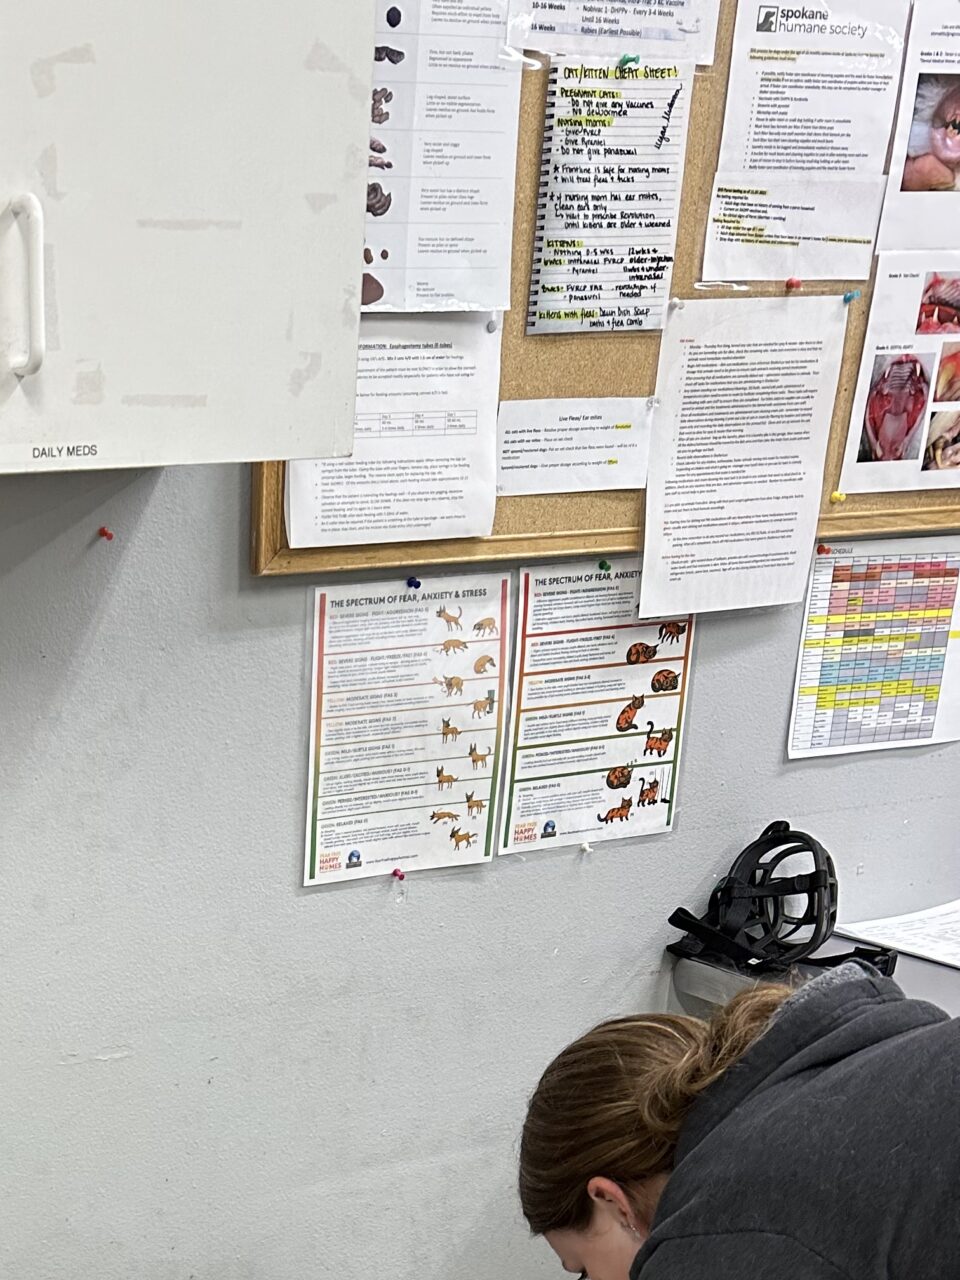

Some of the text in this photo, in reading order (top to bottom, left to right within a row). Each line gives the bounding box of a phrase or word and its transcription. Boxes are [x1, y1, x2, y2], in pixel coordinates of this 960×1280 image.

[533, 2, 547, 10] 10-16
[548, 3, 565, 11] Weeks
[633, 8, 647, 16] Every
[648, 8, 657, 16] 3-4
[657, 9, 674, 17] Weeks
[780, 7, 828, 23] spokane
[595, 16, 602, 24] 16
[602, 17, 620, 25] Weeks
[538, 24, 555, 32] Weeks
[581, 26, 597, 35] Rabies
[779, 21, 867, 39] humane society
[644, 66, 678, 78] SHEET!
[596, 101, 608, 109] give
[611, 101, 623, 110] any
[621, 220, 636, 228] older
[644, 219, 671, 228] weaned
[554, 248, 582, 259] Nothing
[32, 445, 97, 458] DAILY MEDS
[535, 577, 547, 586] THE
[548, 574, 582, 586] SPECTRUM
[584, 573, 593, 582] OF
[595, 572, 613, 583] FEAR,
[330, 599, 344, 608] THE
[346, 595, 385, 607] SPECTRUM
[387, 593, 397, 603] OF
[398, 592, 419, 604] FEAR,
[421, 591, 454, 601] ANXIETY
[462, 588, 487, 598] STRESS
[514, 827, 534, 835] HAPPY
